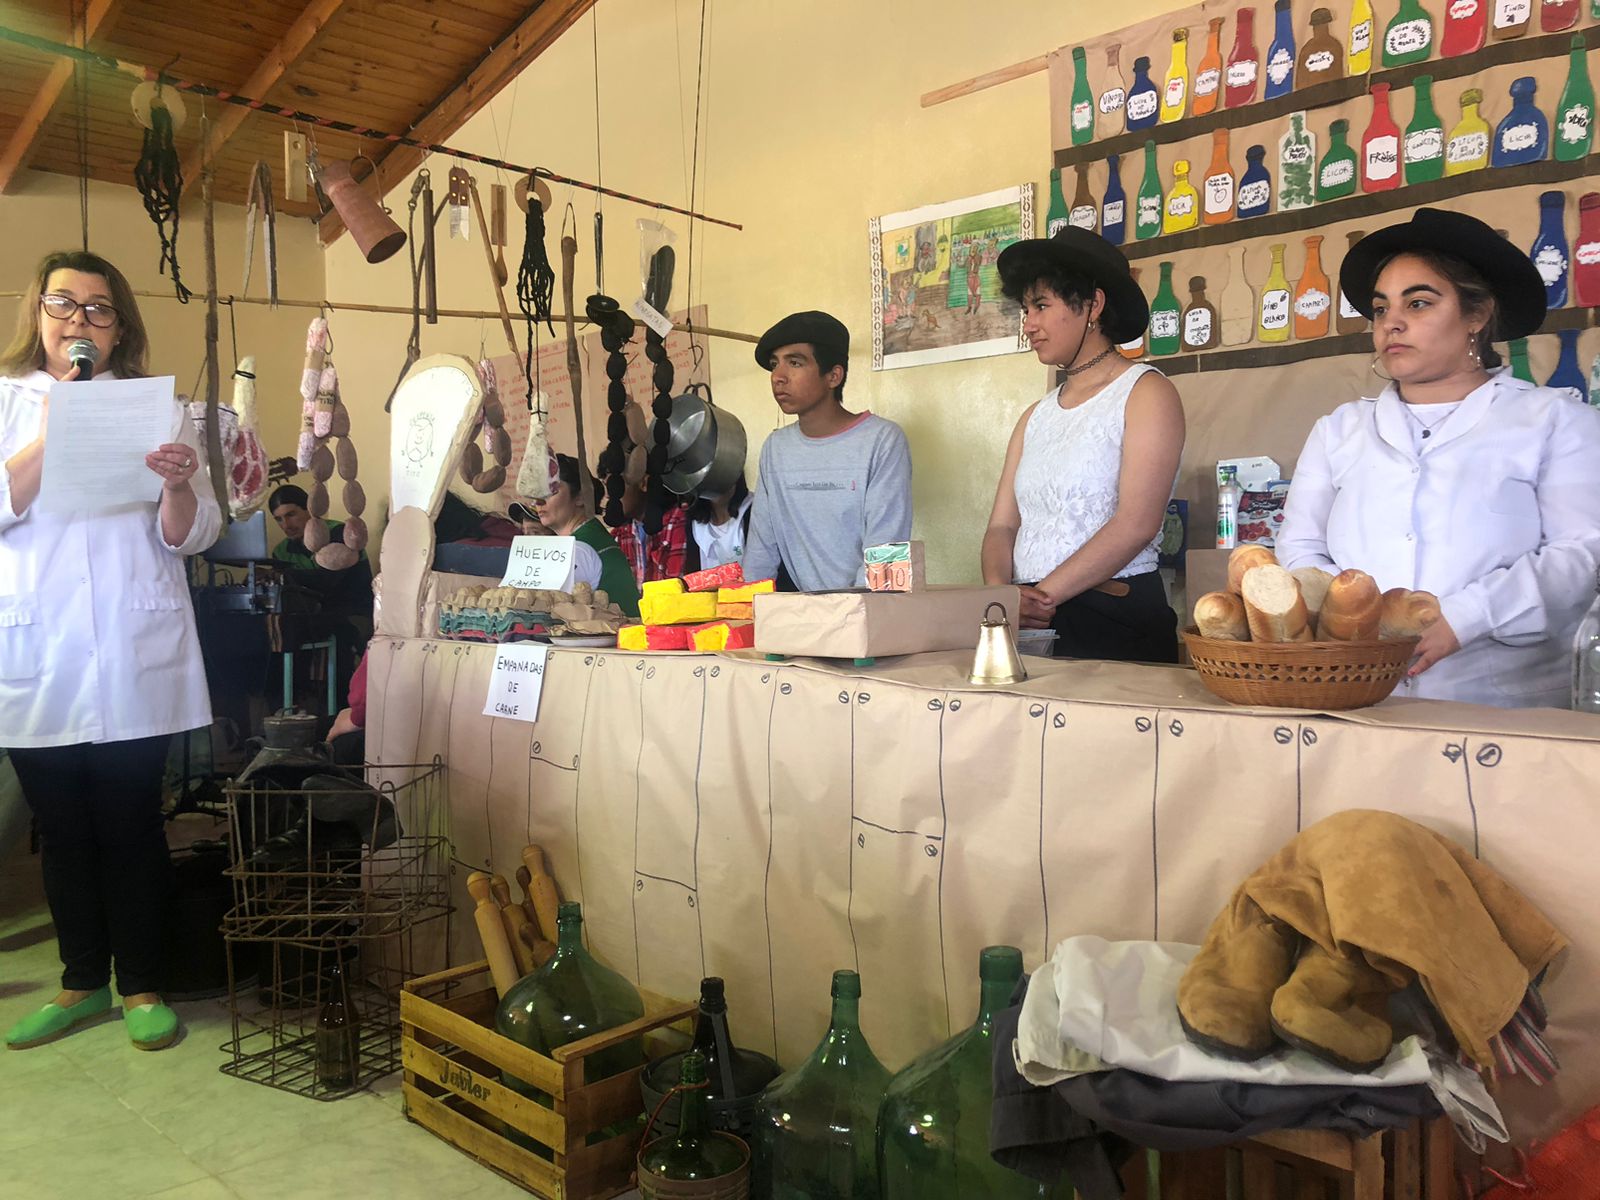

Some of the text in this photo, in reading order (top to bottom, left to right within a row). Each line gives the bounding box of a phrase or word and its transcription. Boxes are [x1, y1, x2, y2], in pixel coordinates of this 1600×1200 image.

[515, 545, 568, 563] HUEVOS
[525, 565, 542, 577] DE
[497, 655, 543, 675] EMPANADAS
[508, 681, 519, 693] DE
